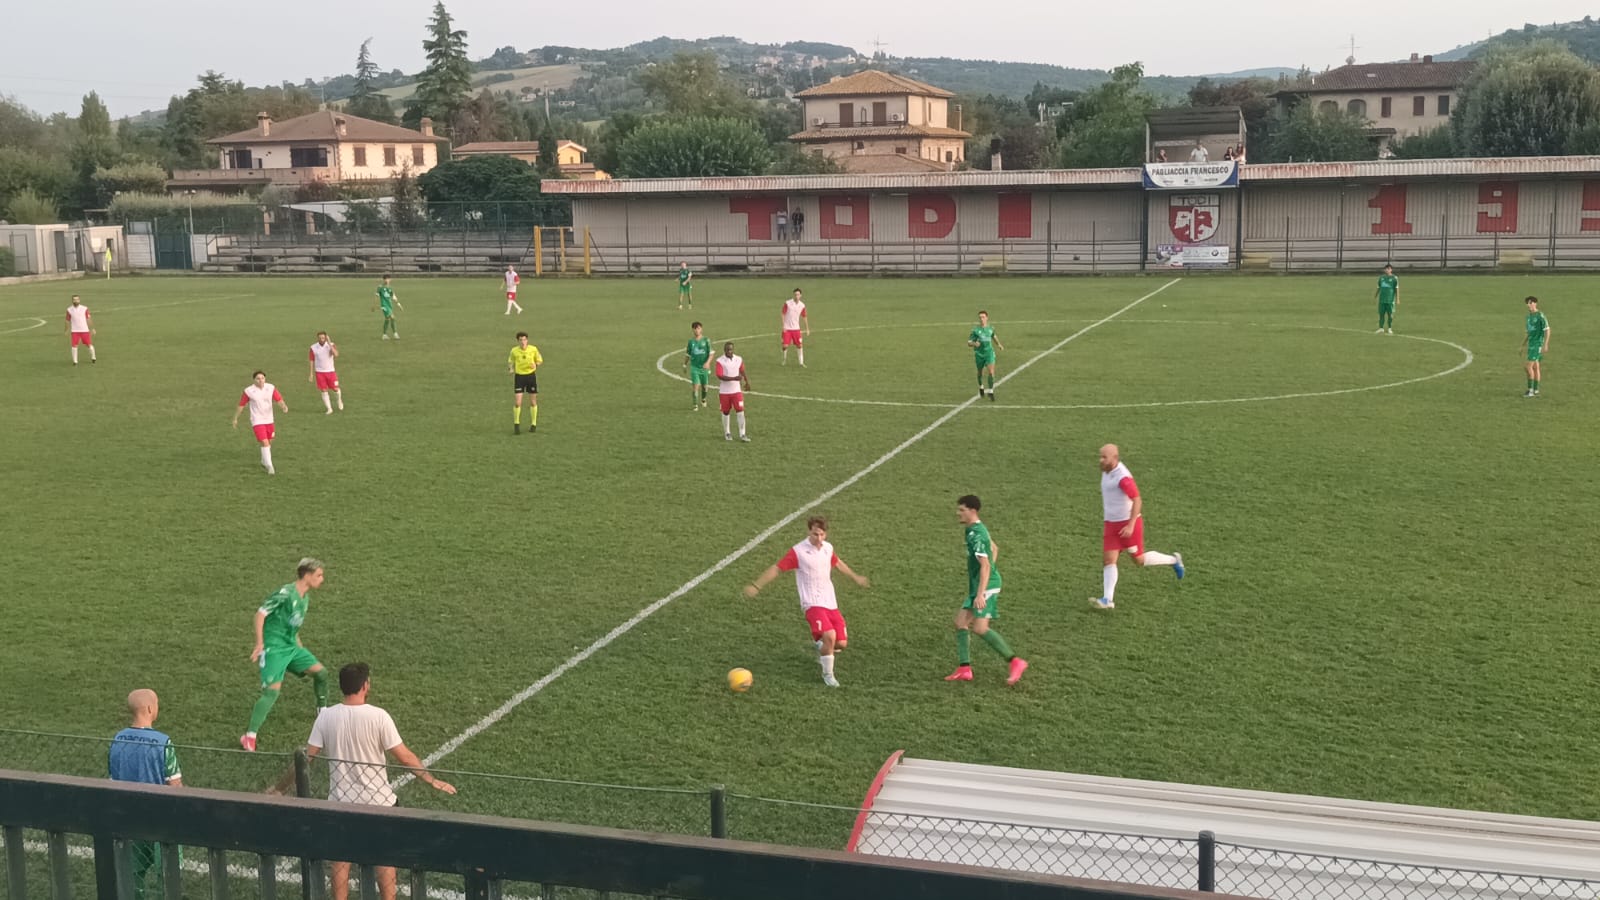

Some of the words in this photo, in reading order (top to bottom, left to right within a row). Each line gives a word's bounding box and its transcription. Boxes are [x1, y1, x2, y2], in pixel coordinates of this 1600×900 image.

[1151, 167, 1189, 176] PAGLIACCIA
[1190, 166, 1229, 176] FRANCESCO
[1176, 195, 1211, 205] TODI
